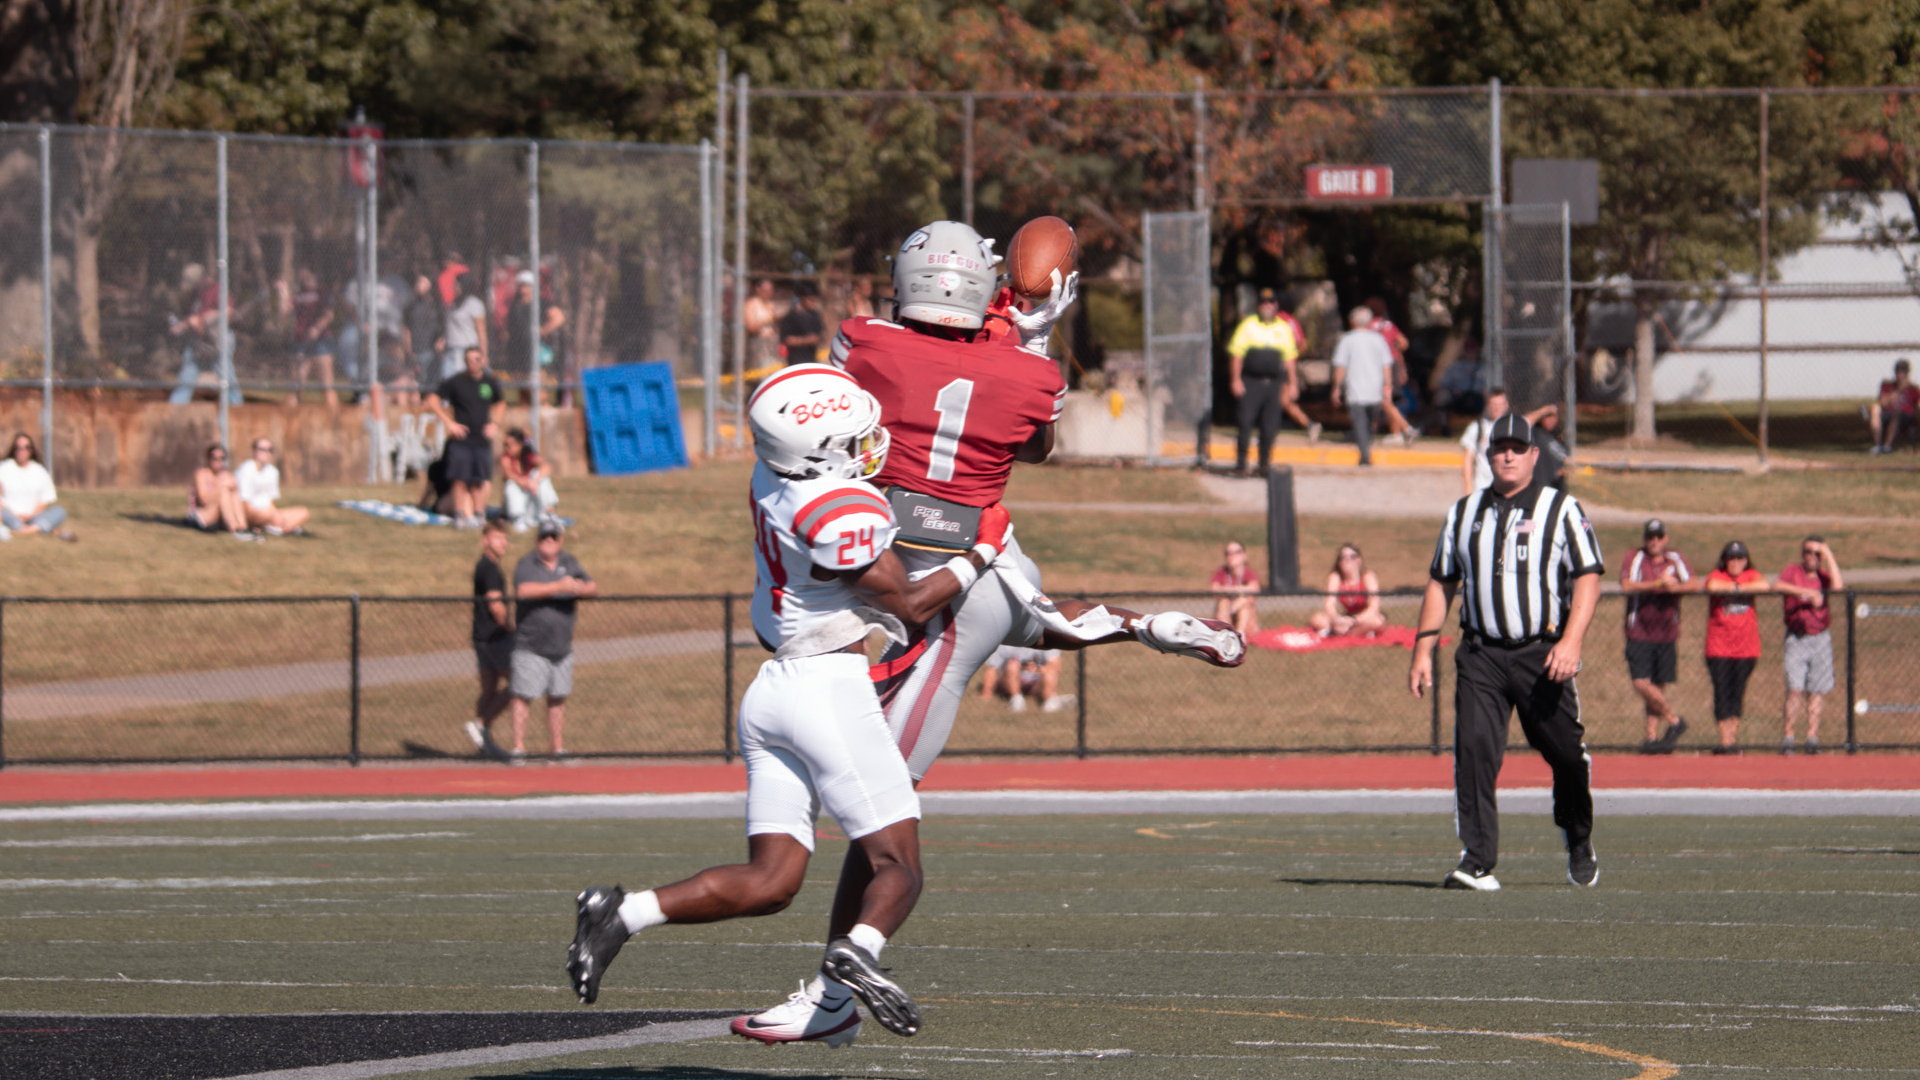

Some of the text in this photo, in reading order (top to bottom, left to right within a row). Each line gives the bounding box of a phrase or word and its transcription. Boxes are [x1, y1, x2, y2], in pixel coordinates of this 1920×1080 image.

[1319, 170, 1360, 195] GATE
[927, 253, 950, 265] BIG
[792, 394, 851, 425] Boro
[926, 378, 974, 482] 1
[913, 506, 943, 519] PRO
[922, 517, 960, 532] GEAR
[837, 525, 875, 565] 24
[1517, 545, 1528, 561] U
